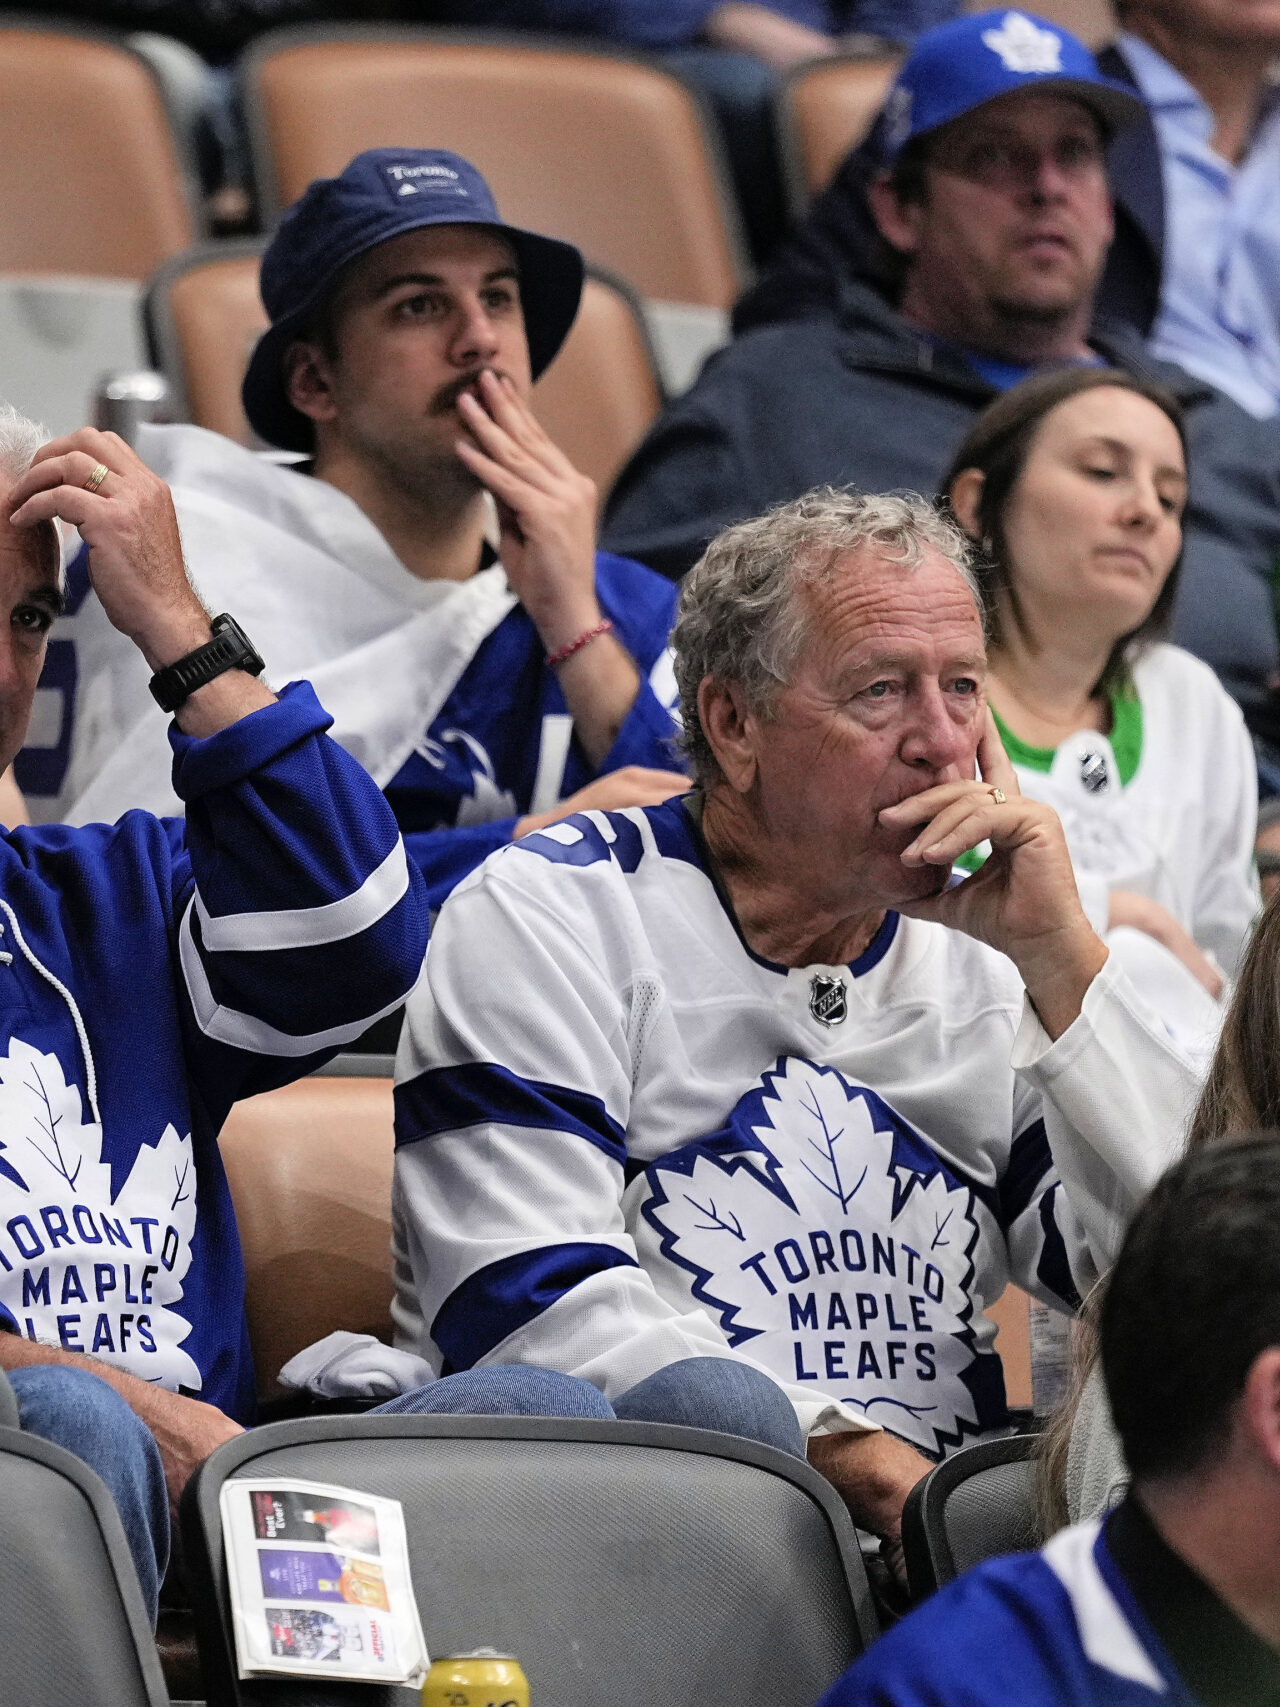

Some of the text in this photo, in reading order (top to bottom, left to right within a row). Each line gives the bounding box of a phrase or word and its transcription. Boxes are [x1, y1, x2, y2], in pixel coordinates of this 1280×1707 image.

[819, 989, 842, 1015] NHL
[22, 1262, 159, 1308] MAPLE
[739, 1228, 945, 1305] TORONTO
[787, 1291, 934, 1333] MAPLE
[793, 1340, 937, 1382] LEAFS
